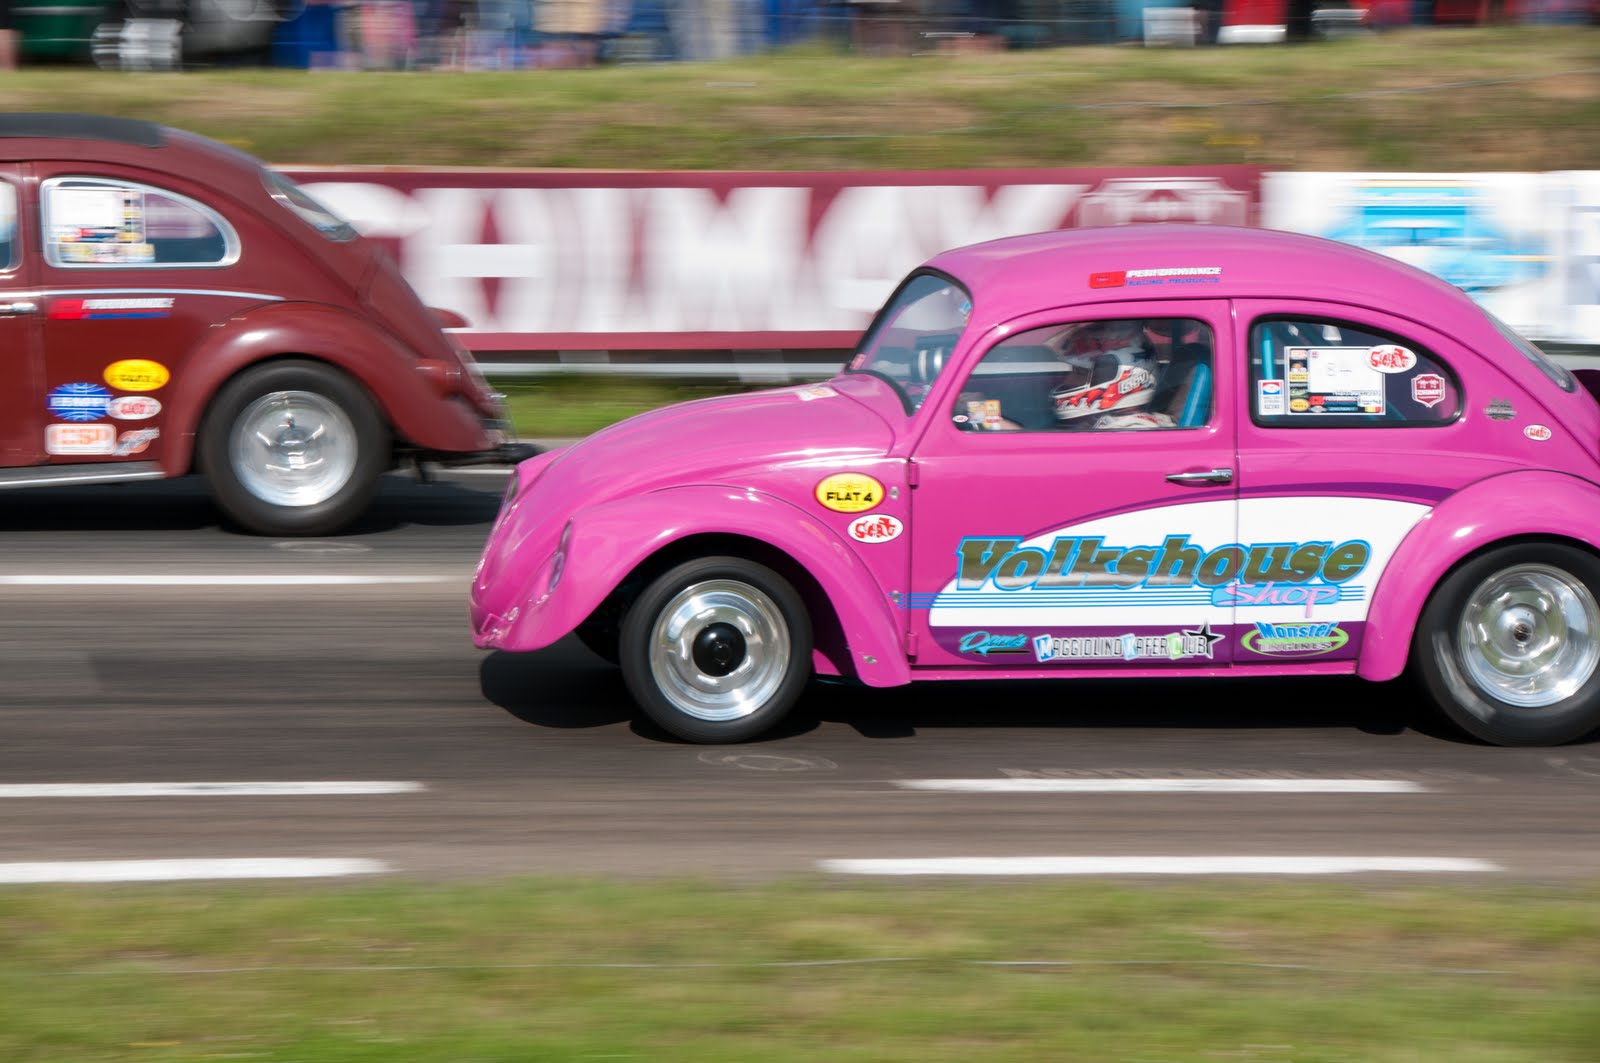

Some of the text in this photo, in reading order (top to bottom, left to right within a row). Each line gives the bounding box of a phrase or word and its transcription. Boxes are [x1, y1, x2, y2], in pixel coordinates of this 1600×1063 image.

[1126, 267, 1222, 278] PERFORMANCE
[826, 491, 873, 502] FLAT 4
[955, 534, 1371, 591] Volkshouse
[1216, 580, 1339, 619] Shop
[1253, 621, 1340, 640] Monster
